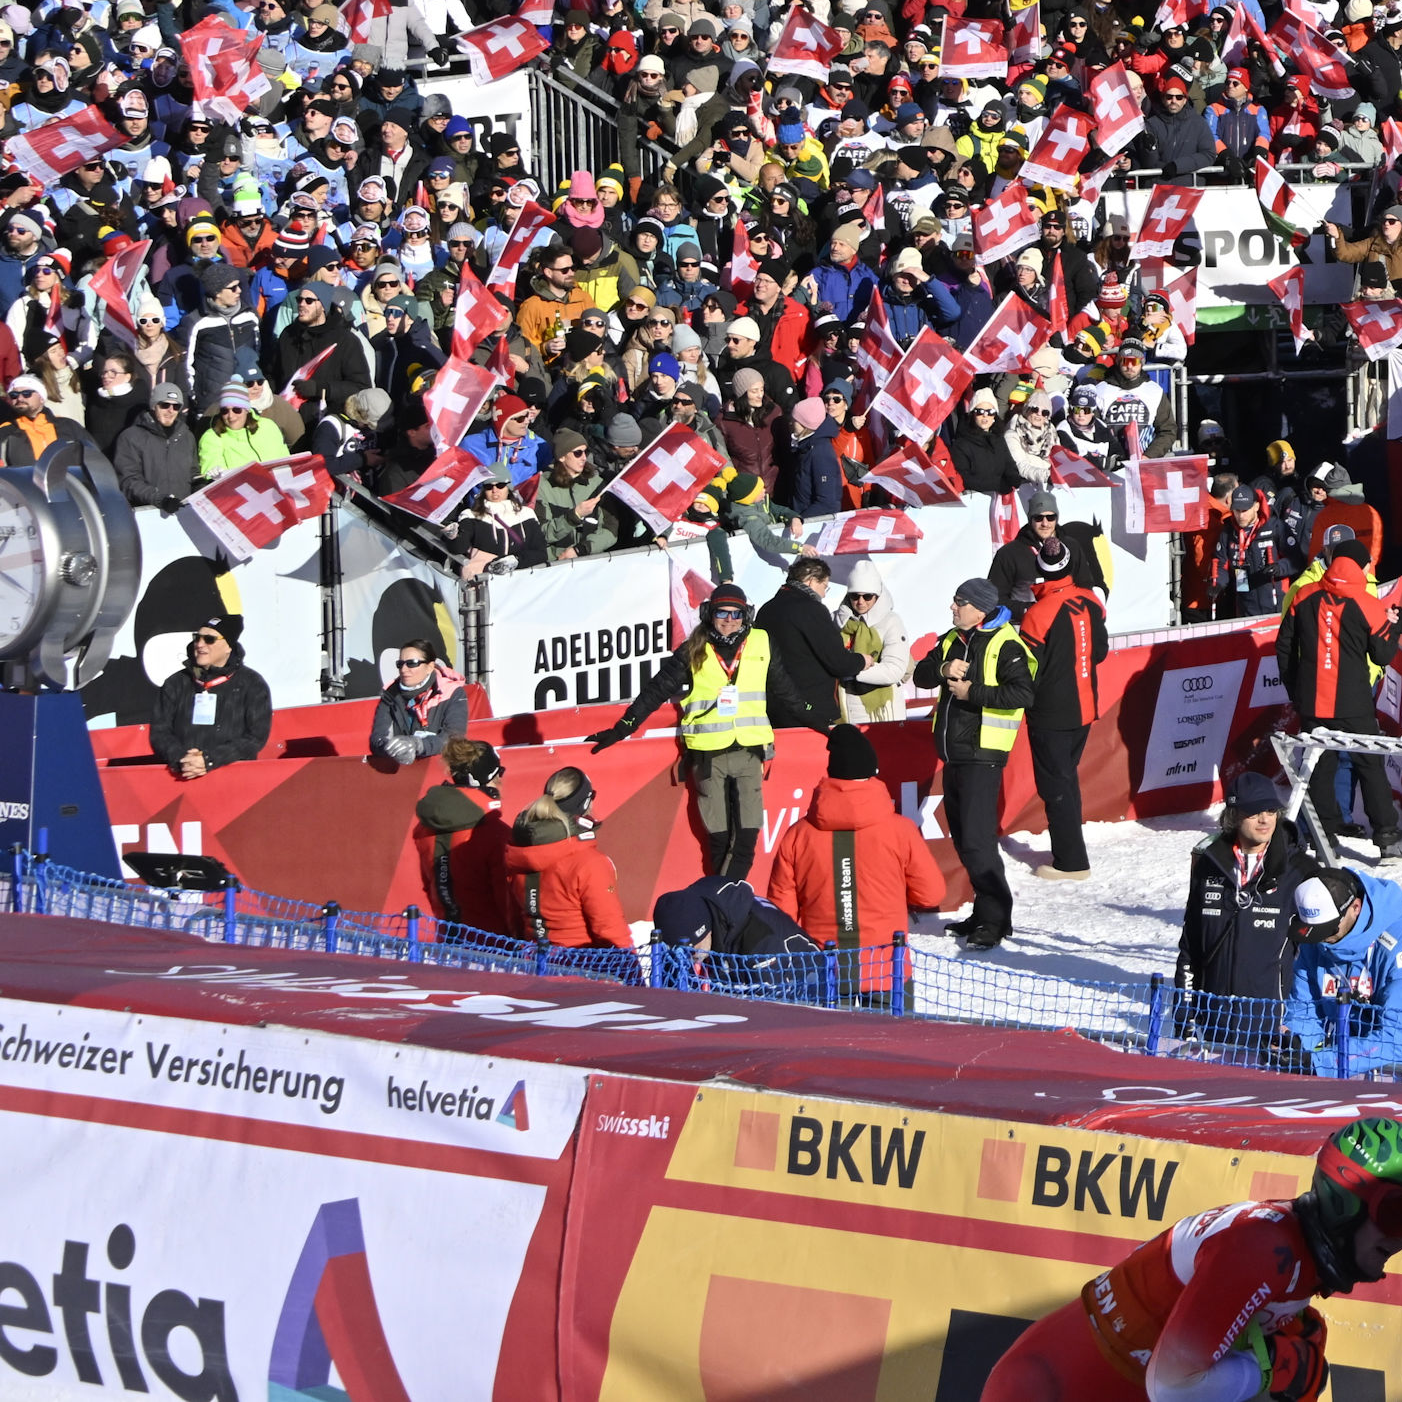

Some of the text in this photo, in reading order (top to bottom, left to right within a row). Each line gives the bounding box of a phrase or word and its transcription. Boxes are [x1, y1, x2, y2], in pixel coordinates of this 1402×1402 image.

[1110, 403, 1145, 413] CAFFÈ
[534, 618, 672, 674] ADELBODE
[1177, 711, 1215, 725] LONGINES
[841, 857, 851, 886] team
[1253, 918, 1276, 928] enel
[0, 1022, 346, 1114] chweizer Versicherung
[387, 1075, 494, 1121] helvetia
[596, 1110, 671, 1139] swissski
[786, 1116, 925, 1190] BKW
[1033, 1145, 1179, 1222] BKW
[1213, 1281, 1273, 1361] RAIFFEISEN
